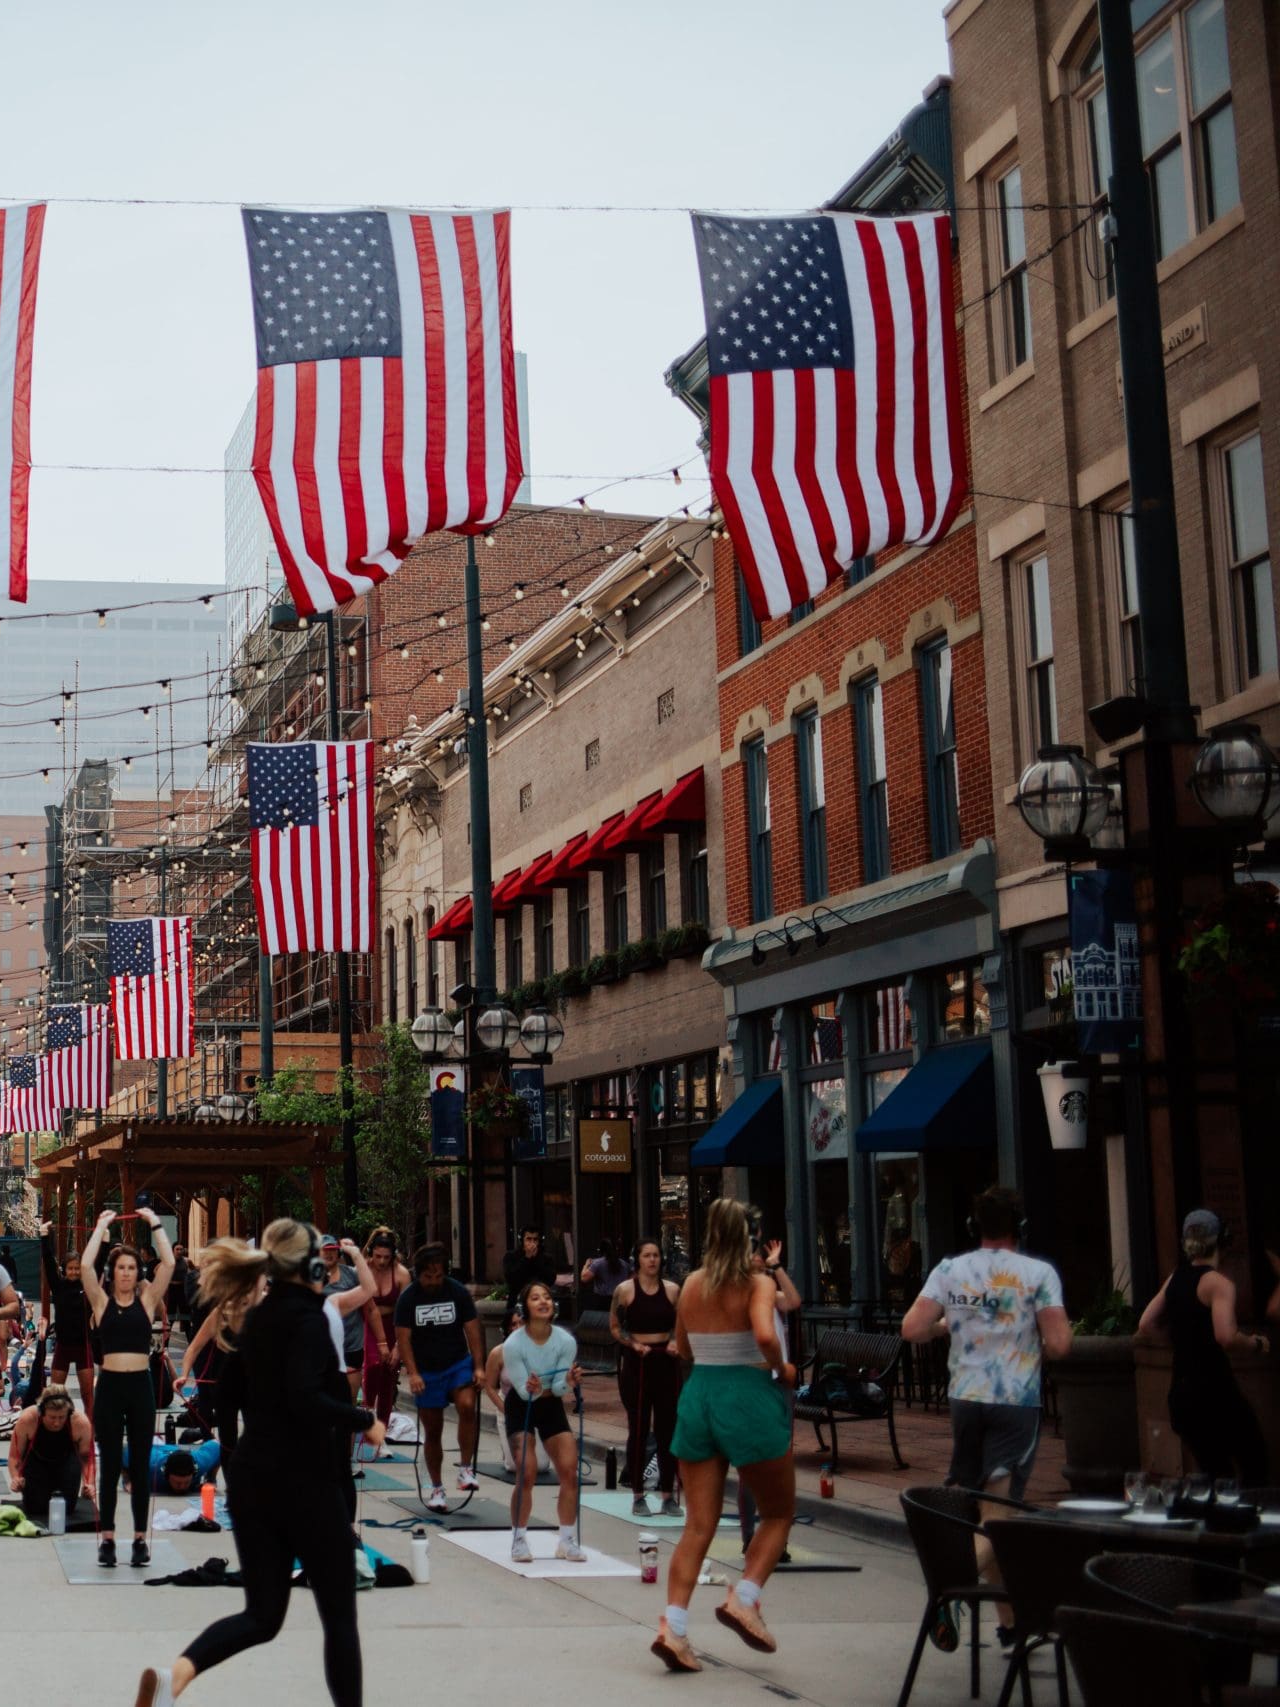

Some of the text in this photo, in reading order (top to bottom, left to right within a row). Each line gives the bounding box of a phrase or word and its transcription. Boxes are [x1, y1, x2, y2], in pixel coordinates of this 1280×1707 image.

[1164, 325, 1194, 354] AND
[584, 1152, 626, 1163] cotopaxi
[948, 1290, 1000, 1309] hazlo
[415, 1301, 456, 1326] F45
